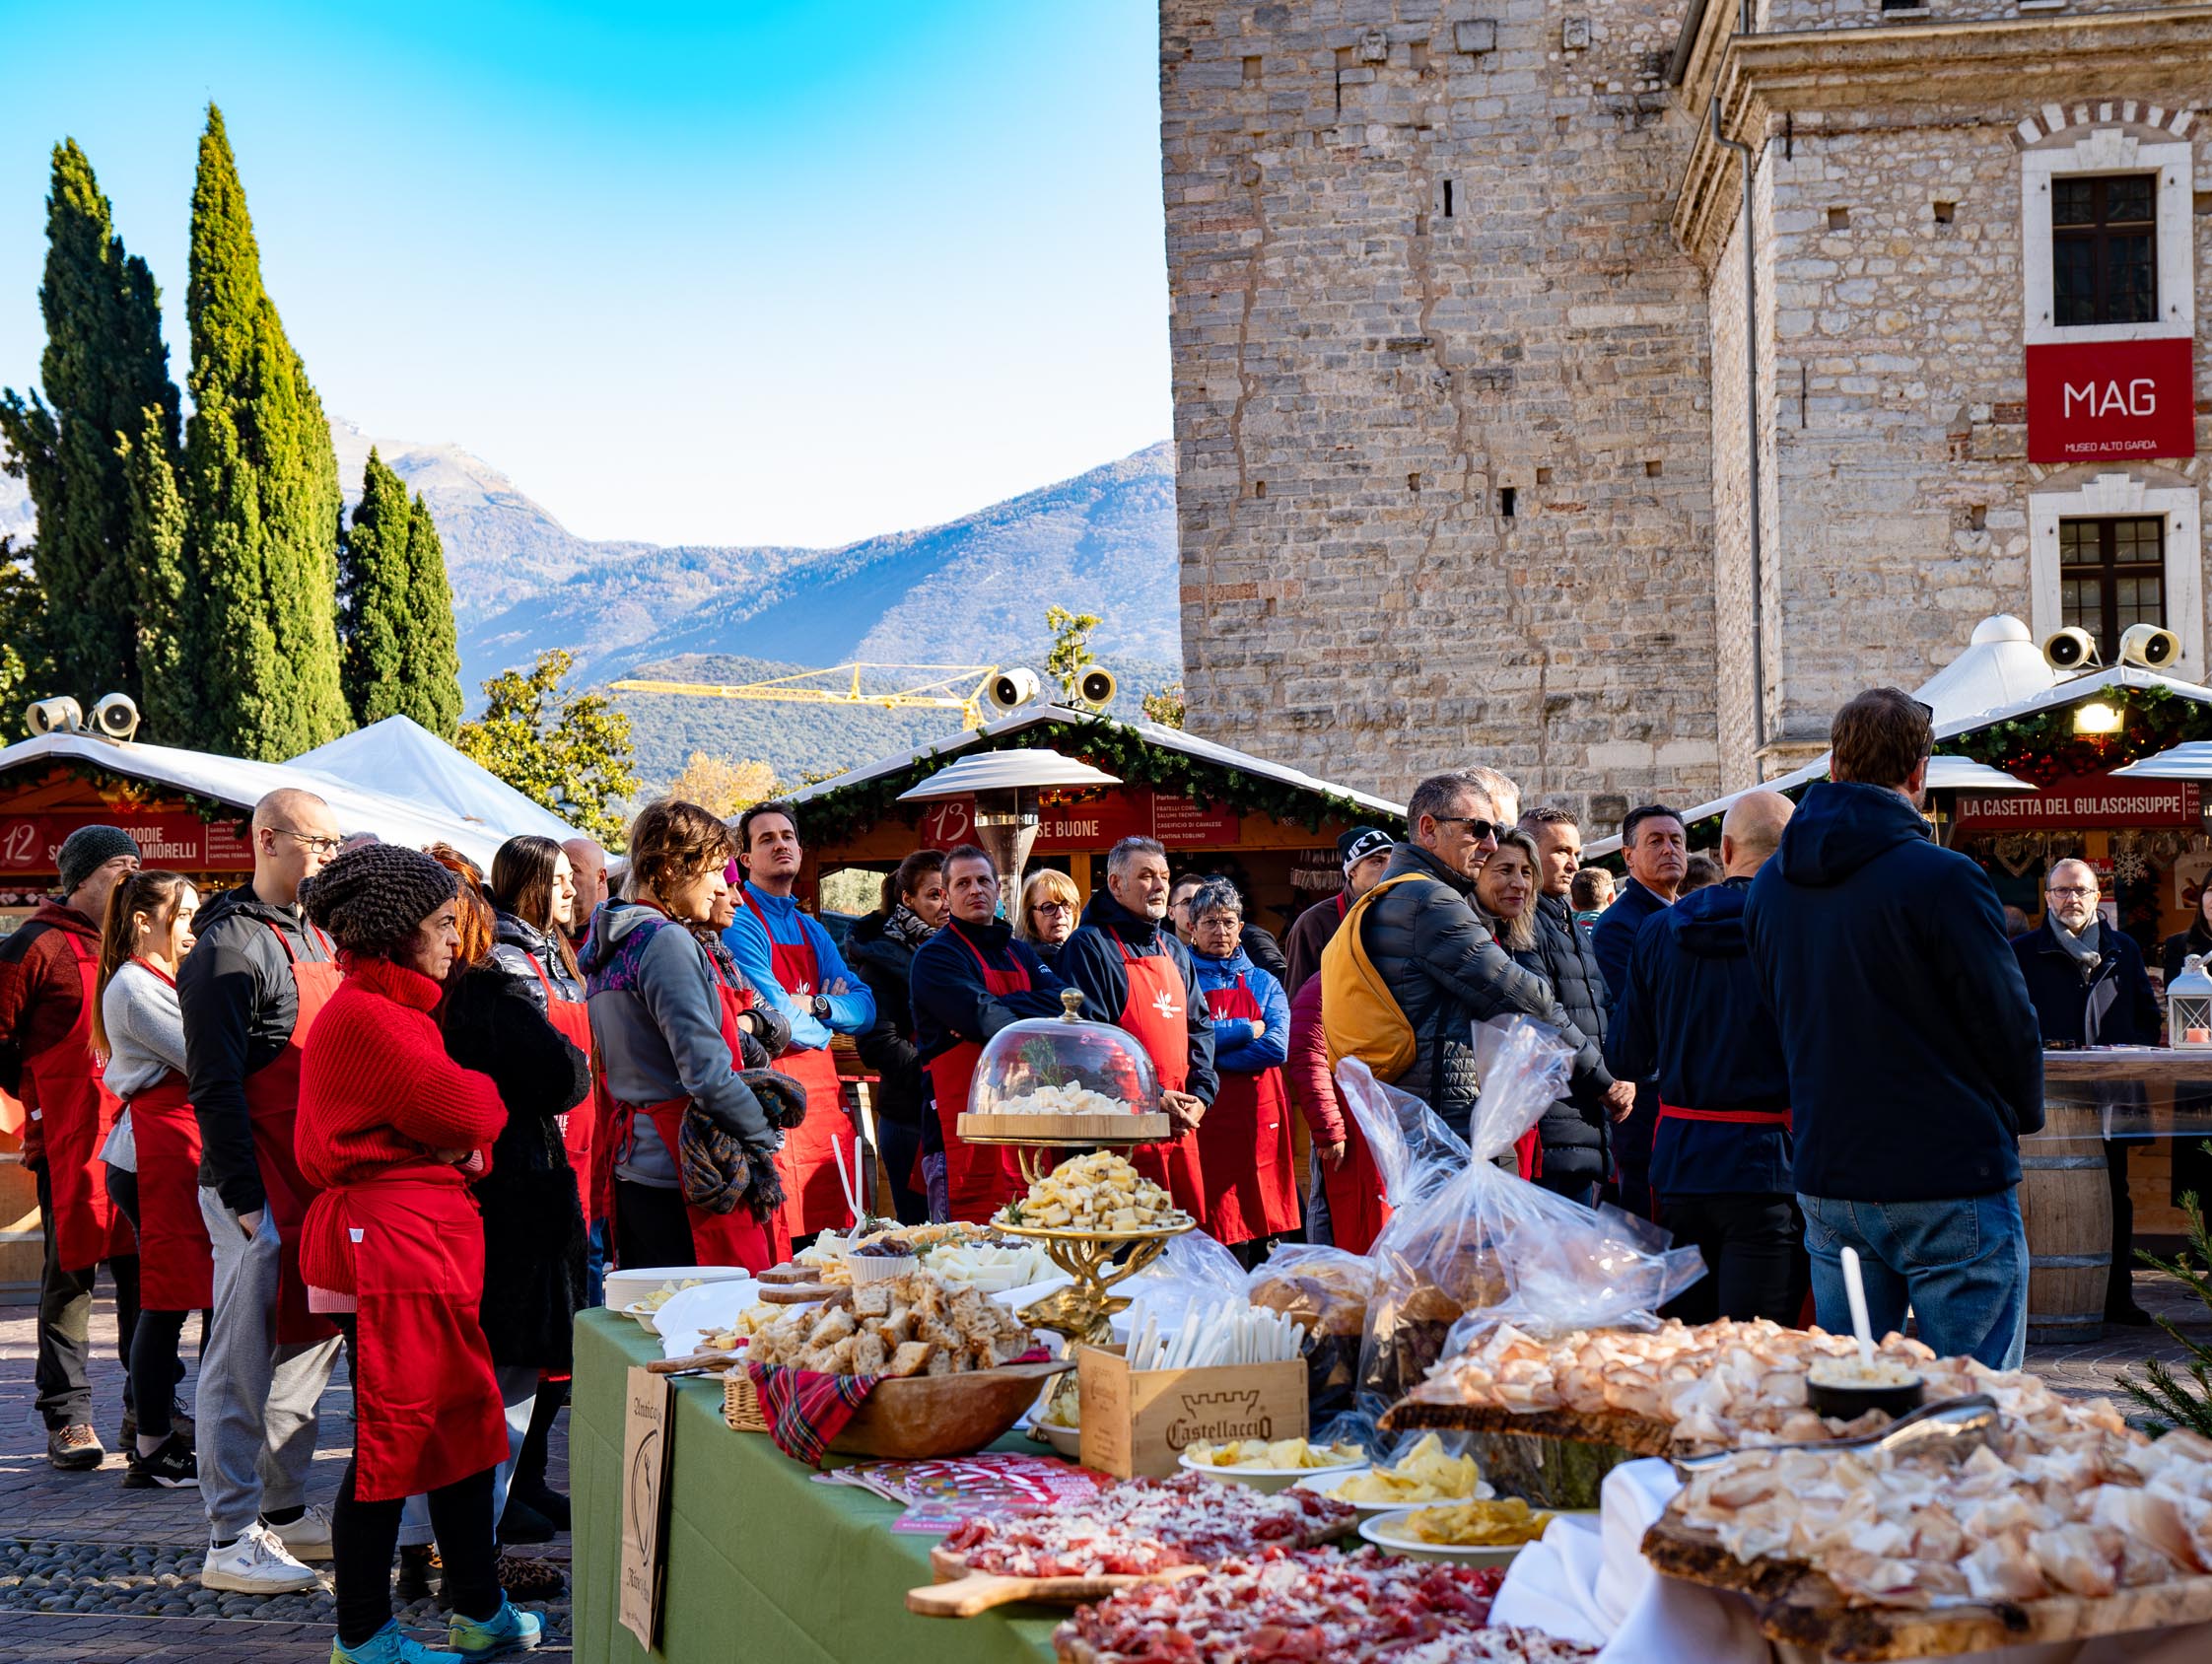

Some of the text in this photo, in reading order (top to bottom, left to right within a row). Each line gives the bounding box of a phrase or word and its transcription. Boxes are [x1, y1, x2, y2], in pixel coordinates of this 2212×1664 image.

[2064, 378, 2156, 419] MAG
[2065, 440, 2158, 452] MUSEO ALTO GARDA
[1964, 796, 2180, 816] LA CASETTA DEL GULASCHSUPPE
[932, 802, 969, 842] 13
[1056, 819, 1100, 837] BUONE
[2, 824, 35, 861] 12
[141, 842, 197, 860] MIORELLI
